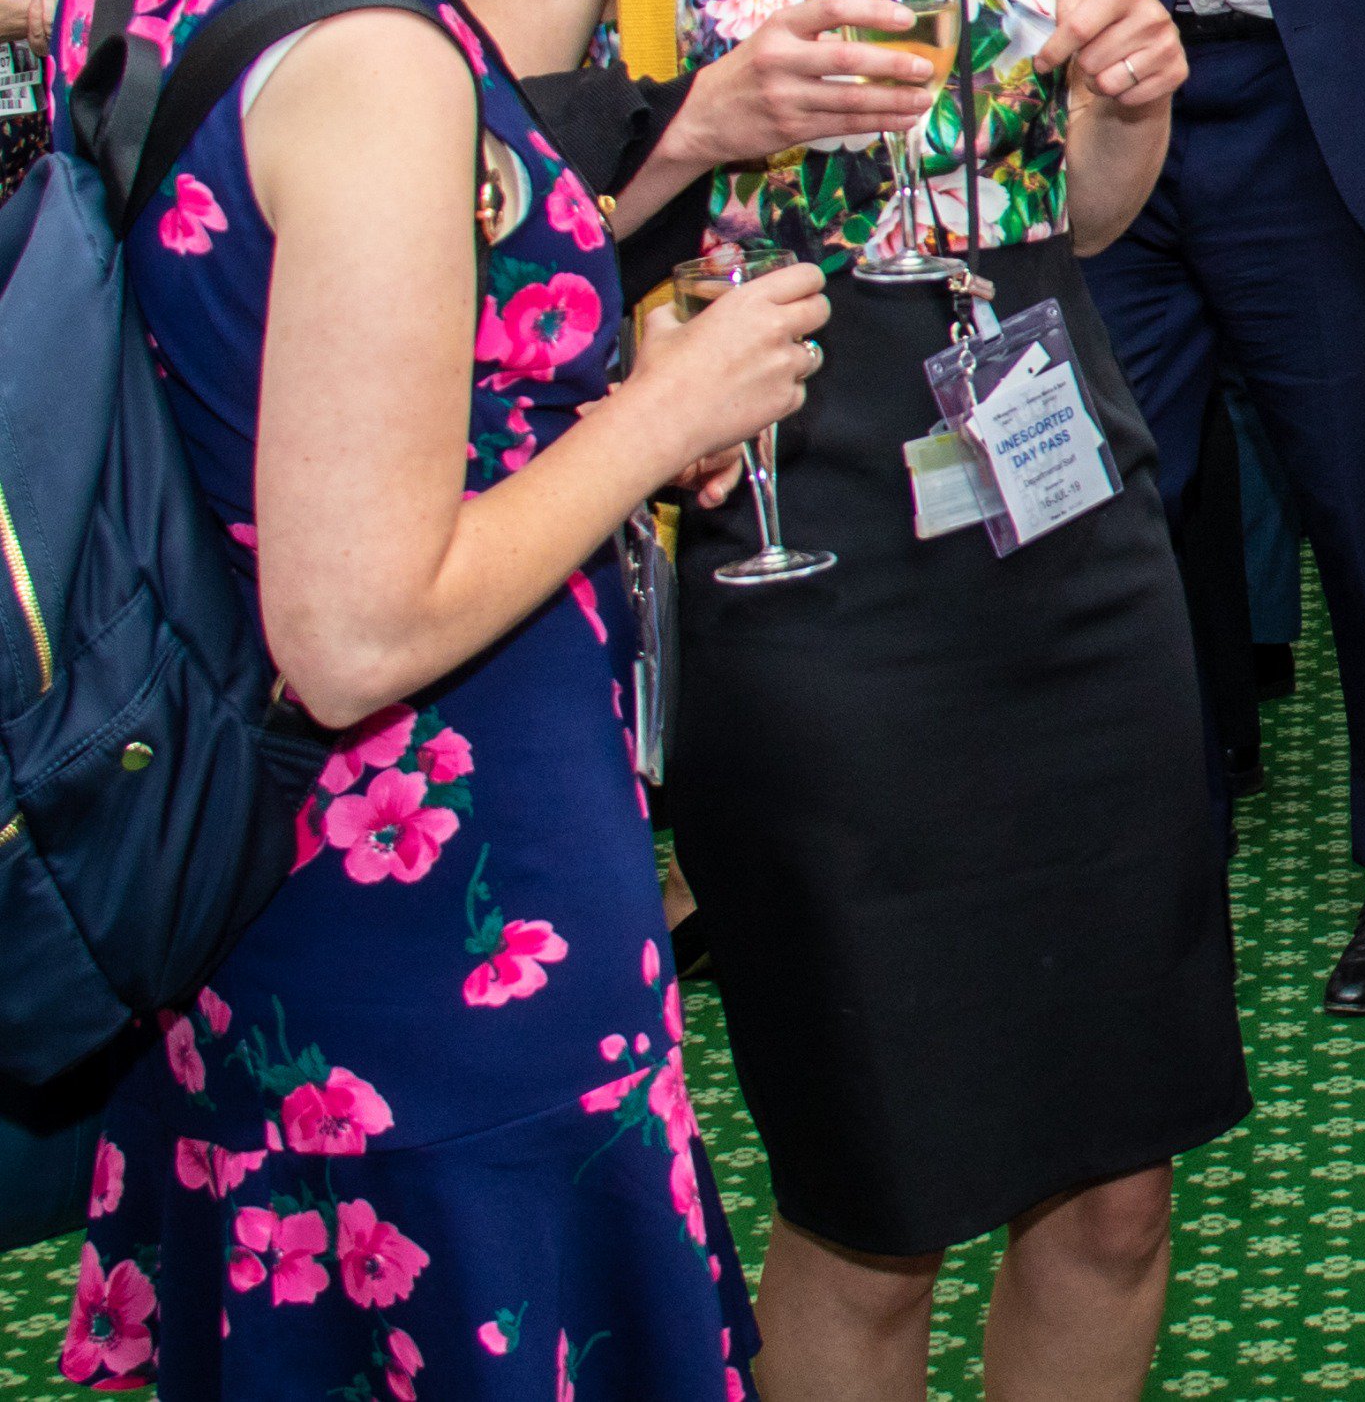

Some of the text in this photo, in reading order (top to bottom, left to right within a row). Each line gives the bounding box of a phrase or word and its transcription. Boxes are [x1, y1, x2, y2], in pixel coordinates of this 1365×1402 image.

[996, 406, 1075, 455] UNESCORTED
[1012, 429, 1071, 468] DAY PASS
